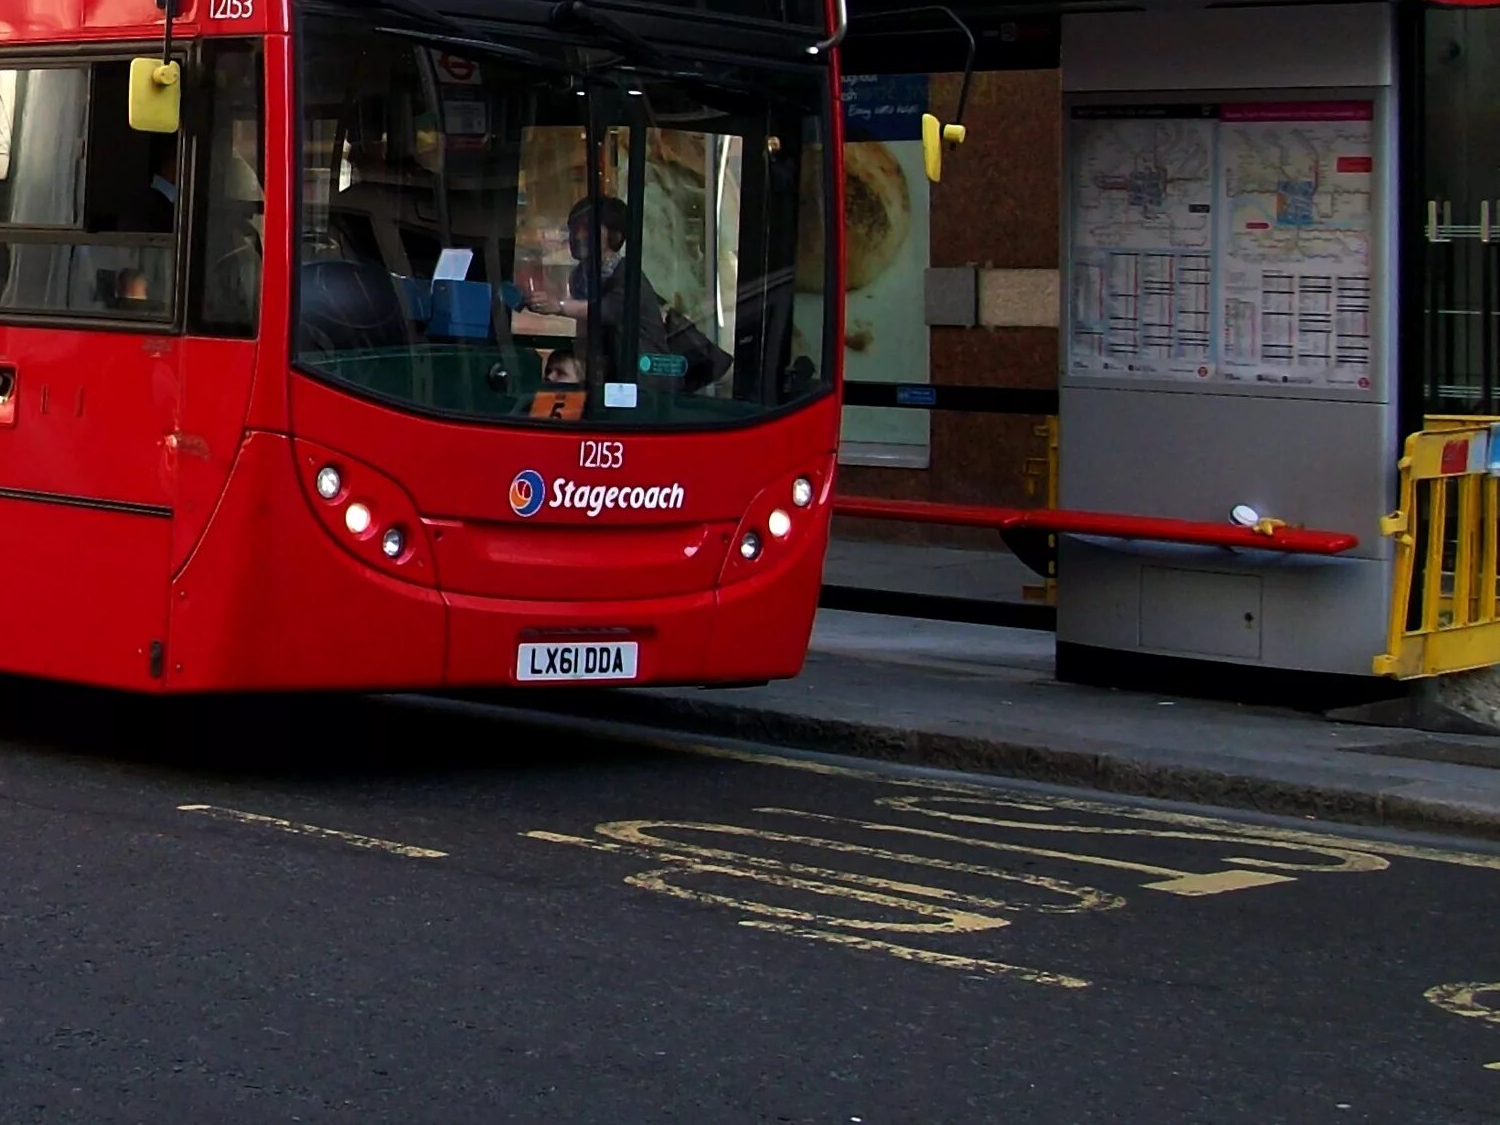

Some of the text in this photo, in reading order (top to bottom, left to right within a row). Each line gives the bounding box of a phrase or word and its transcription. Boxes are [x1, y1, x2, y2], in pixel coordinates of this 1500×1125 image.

[579, 440, 624, 469] 12153
[548, 477, 685, 518] Stagecoach
[530, 647, 624, 675] LX61 DDA
